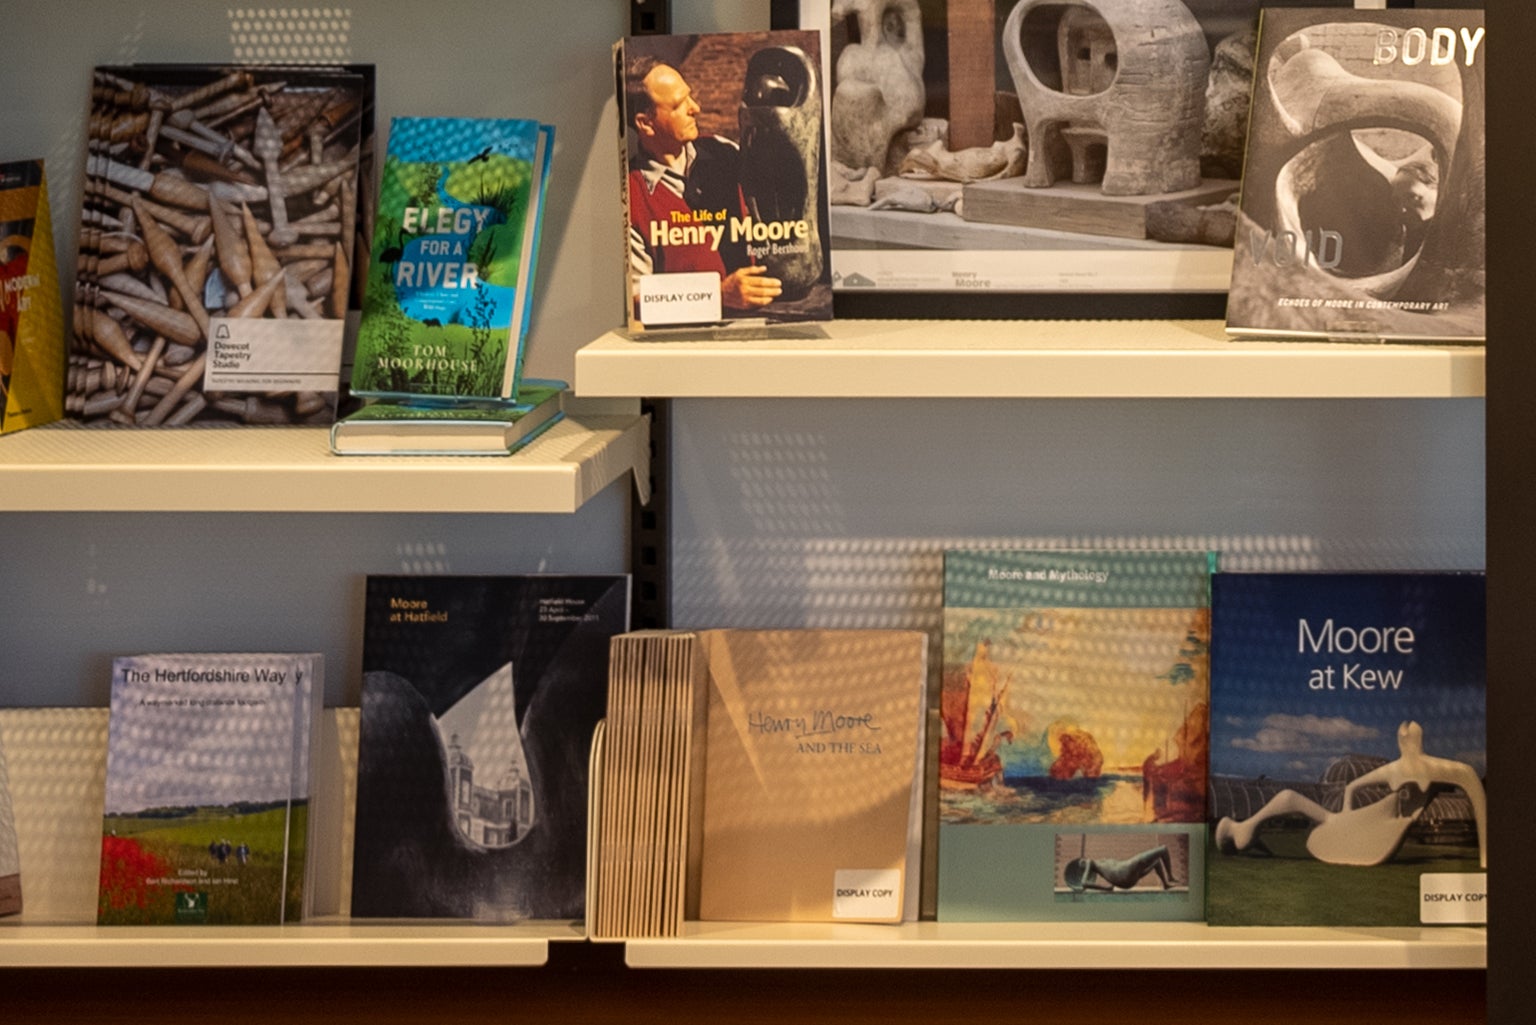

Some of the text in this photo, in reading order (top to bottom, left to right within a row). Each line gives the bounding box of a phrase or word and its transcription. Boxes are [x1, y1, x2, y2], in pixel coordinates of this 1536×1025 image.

[1373, 27, 1485, 66] BODY
[403, 208, 491, 234] ELEGY
[670, 209, 727, 223] The Life of
[650, 216, 809, 251] Henry Moore
[420, 240, 462, 255] FOR A
[396, 262, 479, 289] RIVER
[643, 292, 713, 303] DISPLAY COPY
[214, 341, 249, 350] Dovecot
[413, 345, 446, 356] TOM
[214, 351, 251, 360] Tapestry
[213, 360, 240, 368] Studio
[377, 358, 478, 371] MOORHOUSE
[988, 569, 1109, 583] Moore and Mythology
[390, 598, 427, 608] Moore
[390, 611, 448, 622] at Hatfield
[1298, 618, 1415, 653] Moore
[121, 669, 286, 685] The Hertfordshire Way
[1309, 664, 1403, 690] at Kew
[748, 710, 881, 734] Henry Moore
[795, 743, 882, 753] AND THE SEA
[836, 889, 870, 897] DISPLAY
